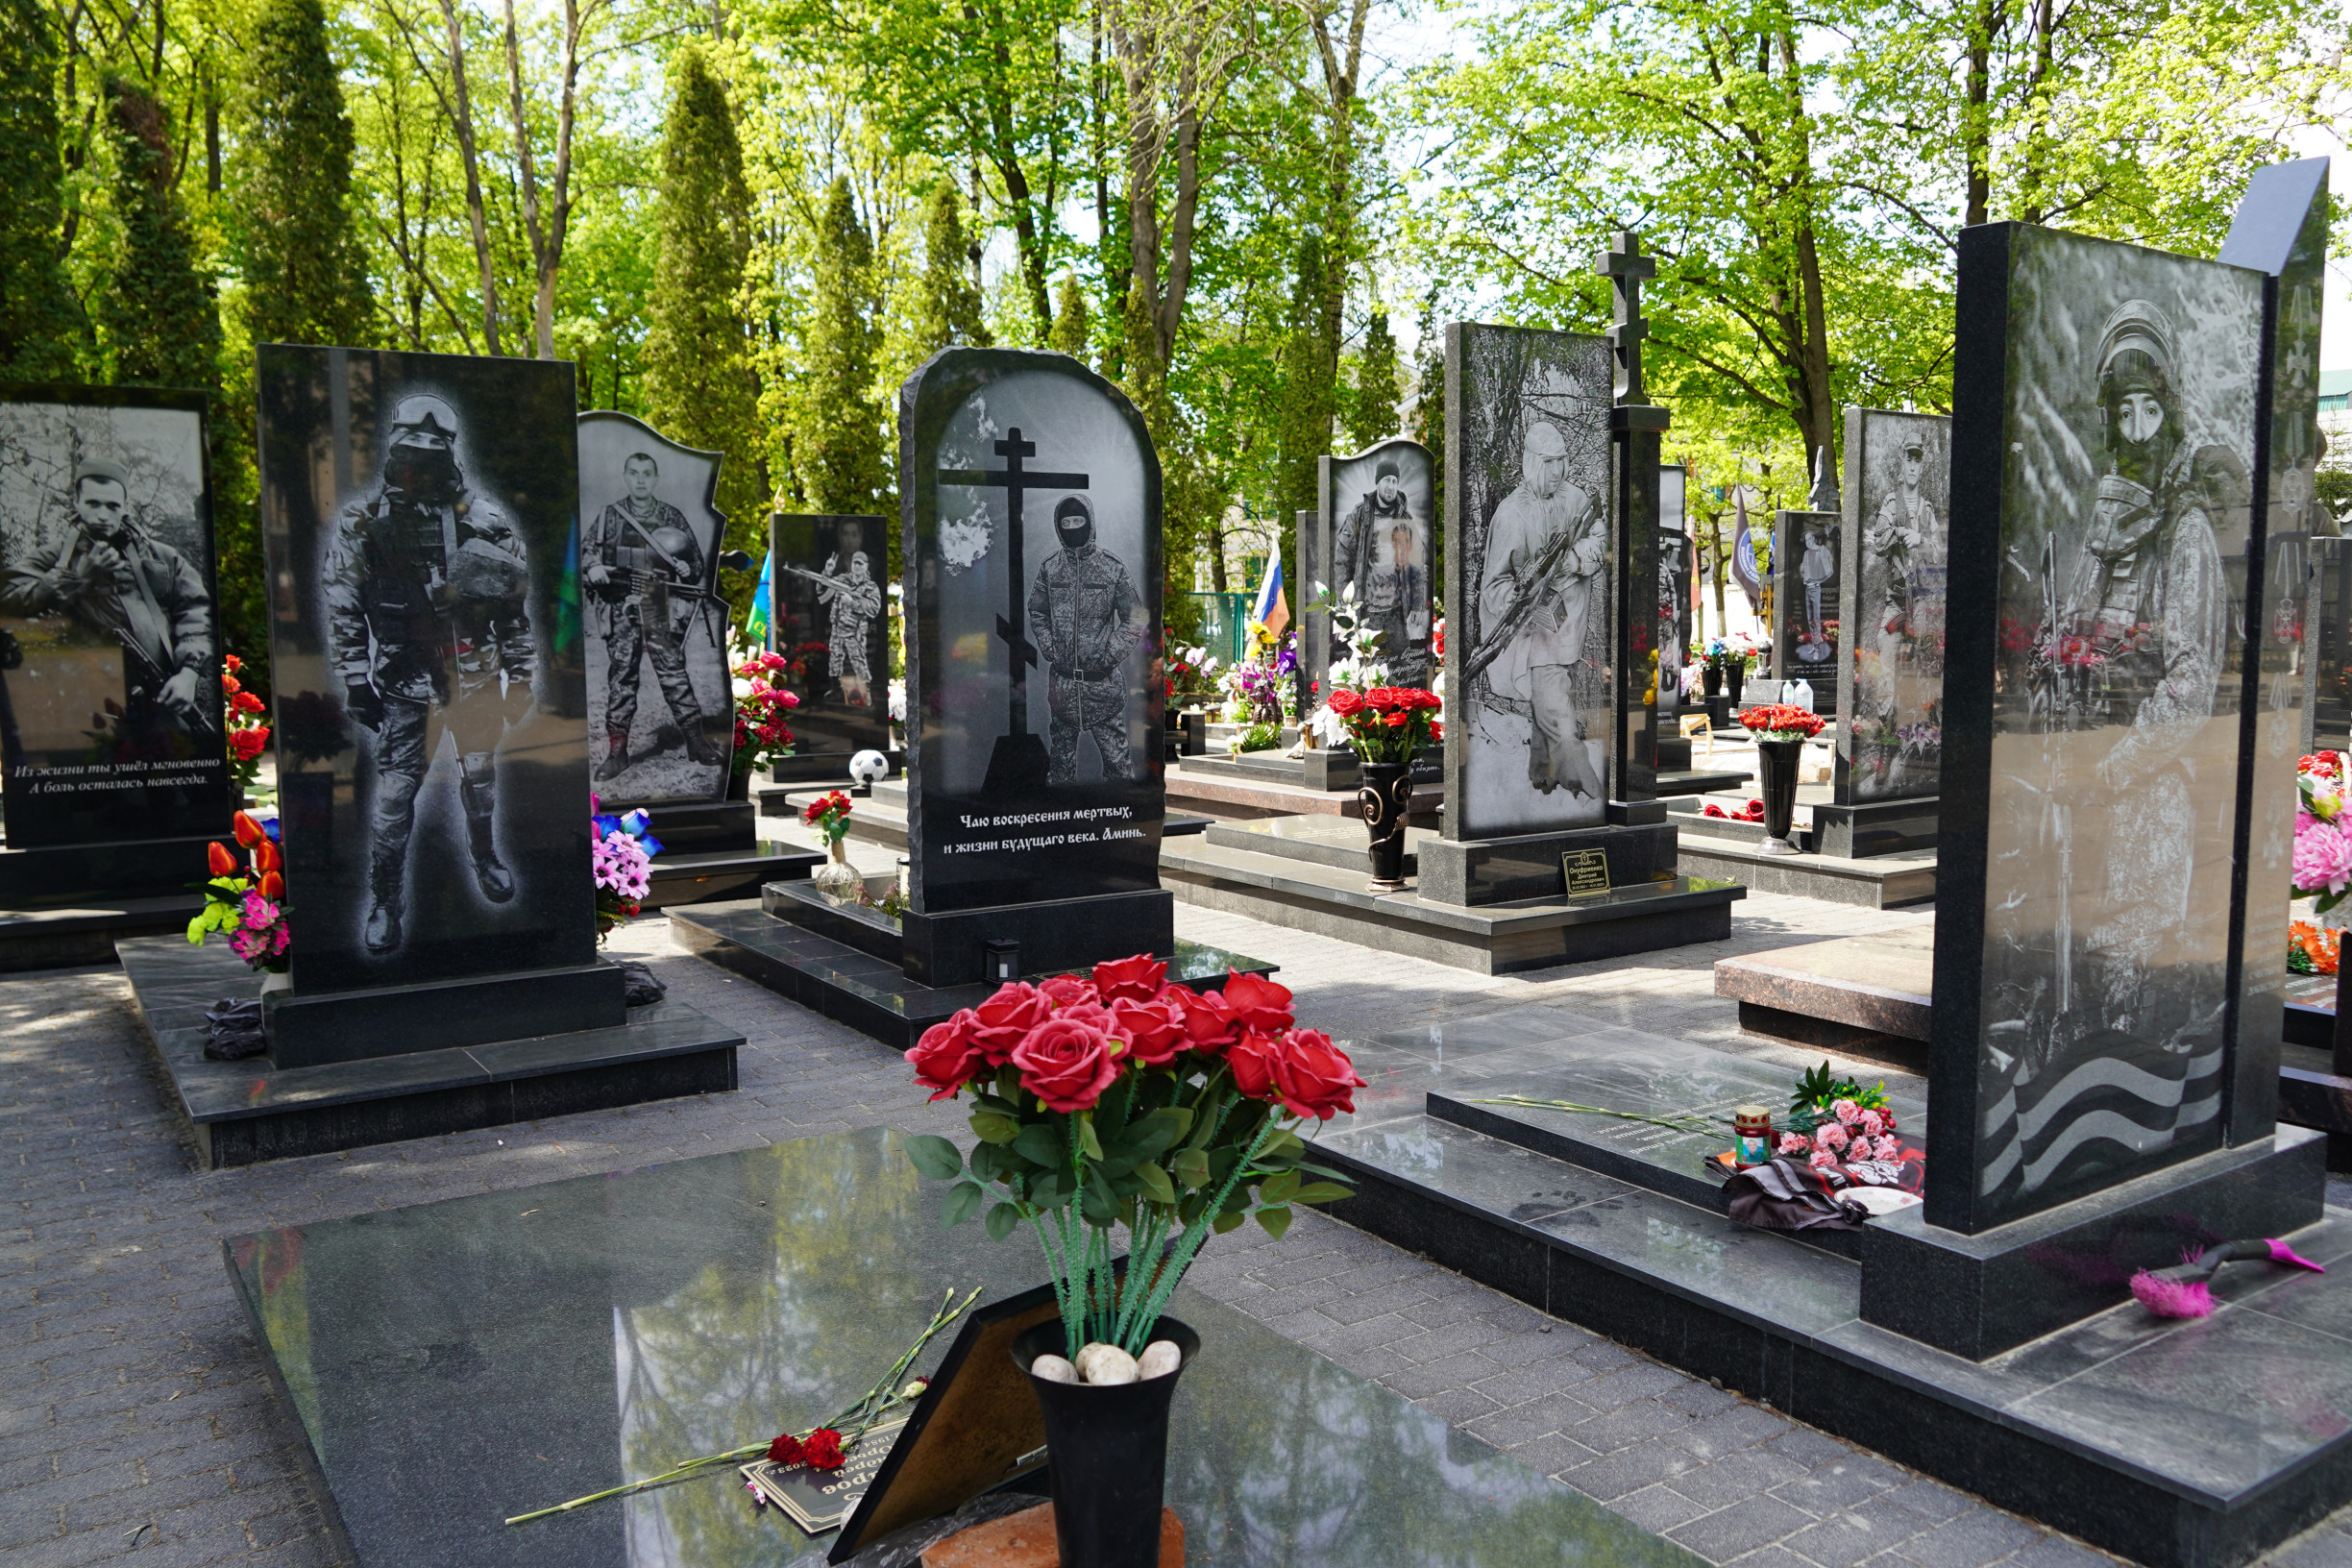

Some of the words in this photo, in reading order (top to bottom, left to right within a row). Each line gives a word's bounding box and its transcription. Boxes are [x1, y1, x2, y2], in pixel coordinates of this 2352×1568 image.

[14, 765, 34, 778] Из
[37, 765, 85, 776] жизни
[87, 764, 110, 773] ты
[113, 760, 148, 775] ушёл
[151, 758, 221, 771] мгновенно
[28, 782, 39, 795] А
[43, 780, 75, 794] боль
[78, 779, 144, 791] осталась
[147, 773, 208, 787] навсегда.
[960, 815, 990, 828] Чаю
[992, 810, 1070, 827] воскресения
[1073, 806, 1133, 821] мертвых,
[943, 844, 952, 854] и
[955, 841, 998, 853] жизни
[1001, 835, 1065, 852] будущаго
[1067, 833, 1099, 844] века.
[1102, 827, 1146, 841] Аминь.
[1569, 866, 1604, 874] Онуфриенко
[832, 1456, 888, 1479] ндрей
